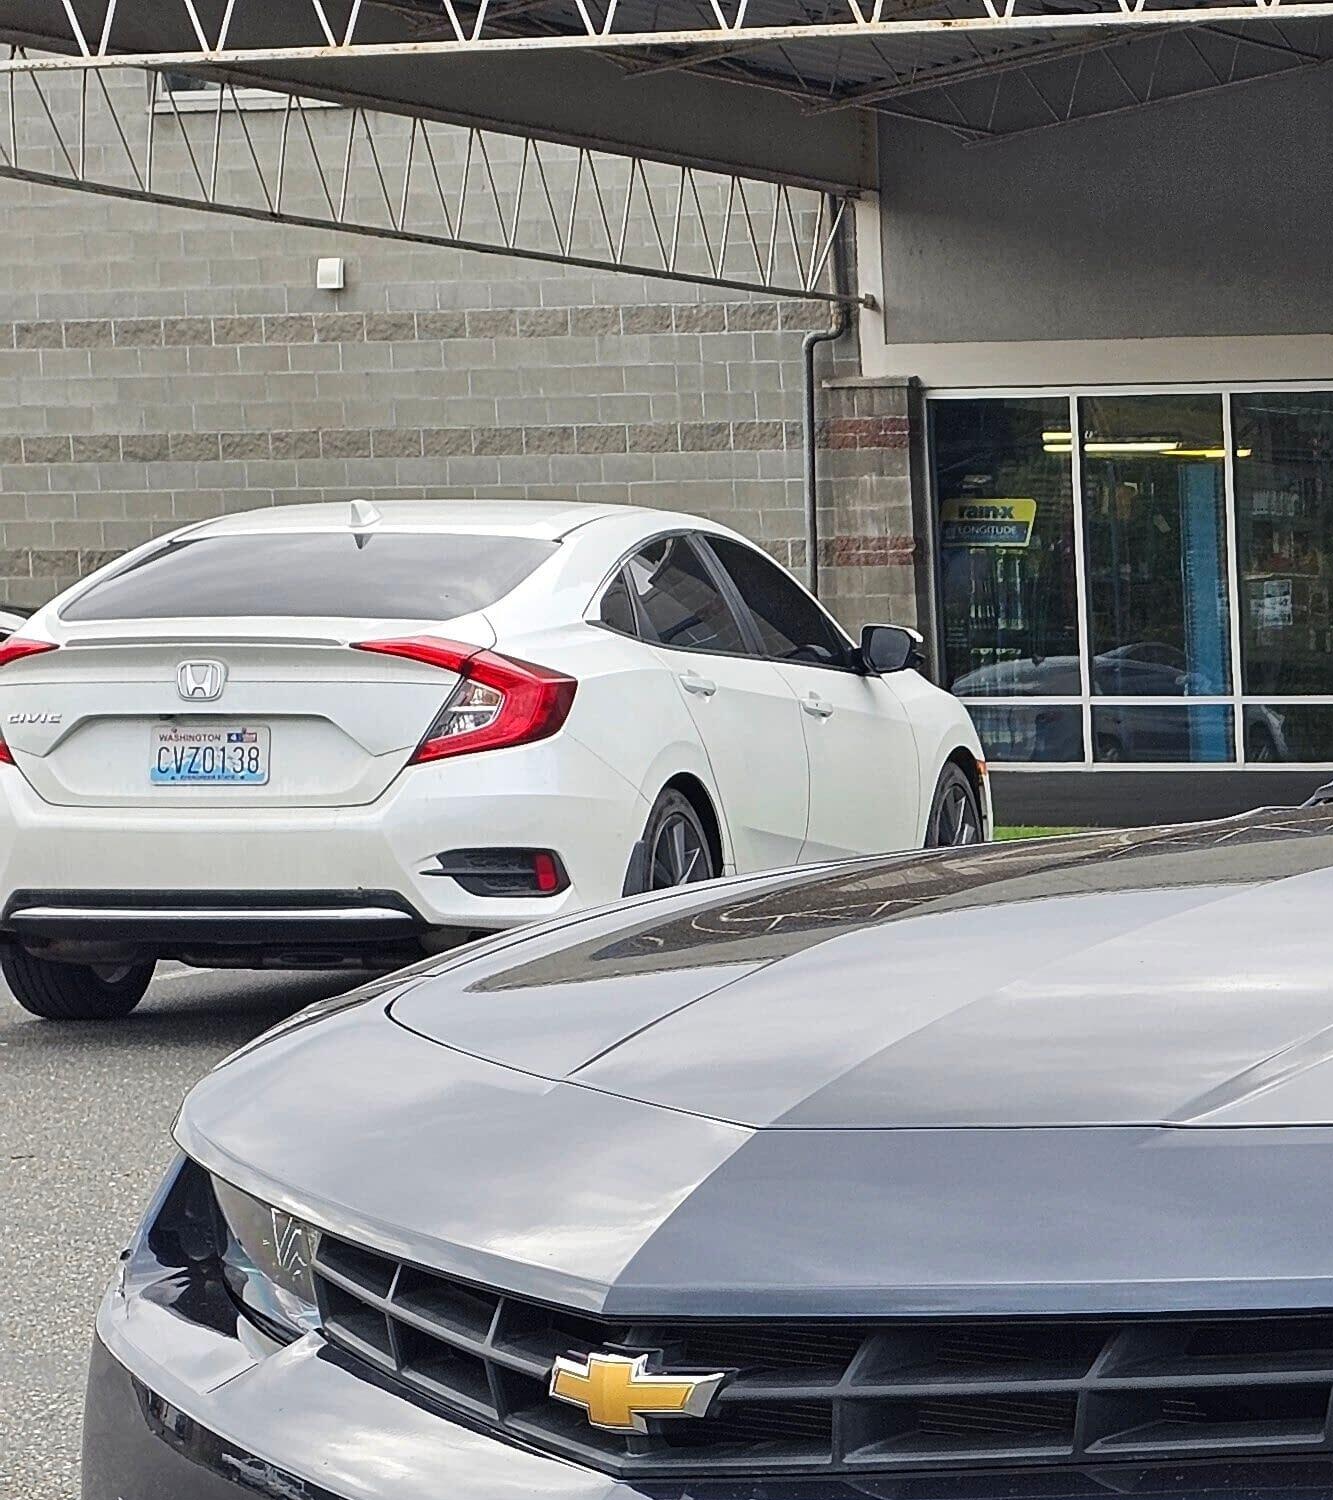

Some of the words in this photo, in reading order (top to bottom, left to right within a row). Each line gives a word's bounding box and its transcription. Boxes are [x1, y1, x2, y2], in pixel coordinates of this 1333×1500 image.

[8, 714, 62, 724] CIVIC
[159, 734, 221, 742] WASHINGTON
[157, 746, 260, 774] CVZ0138
